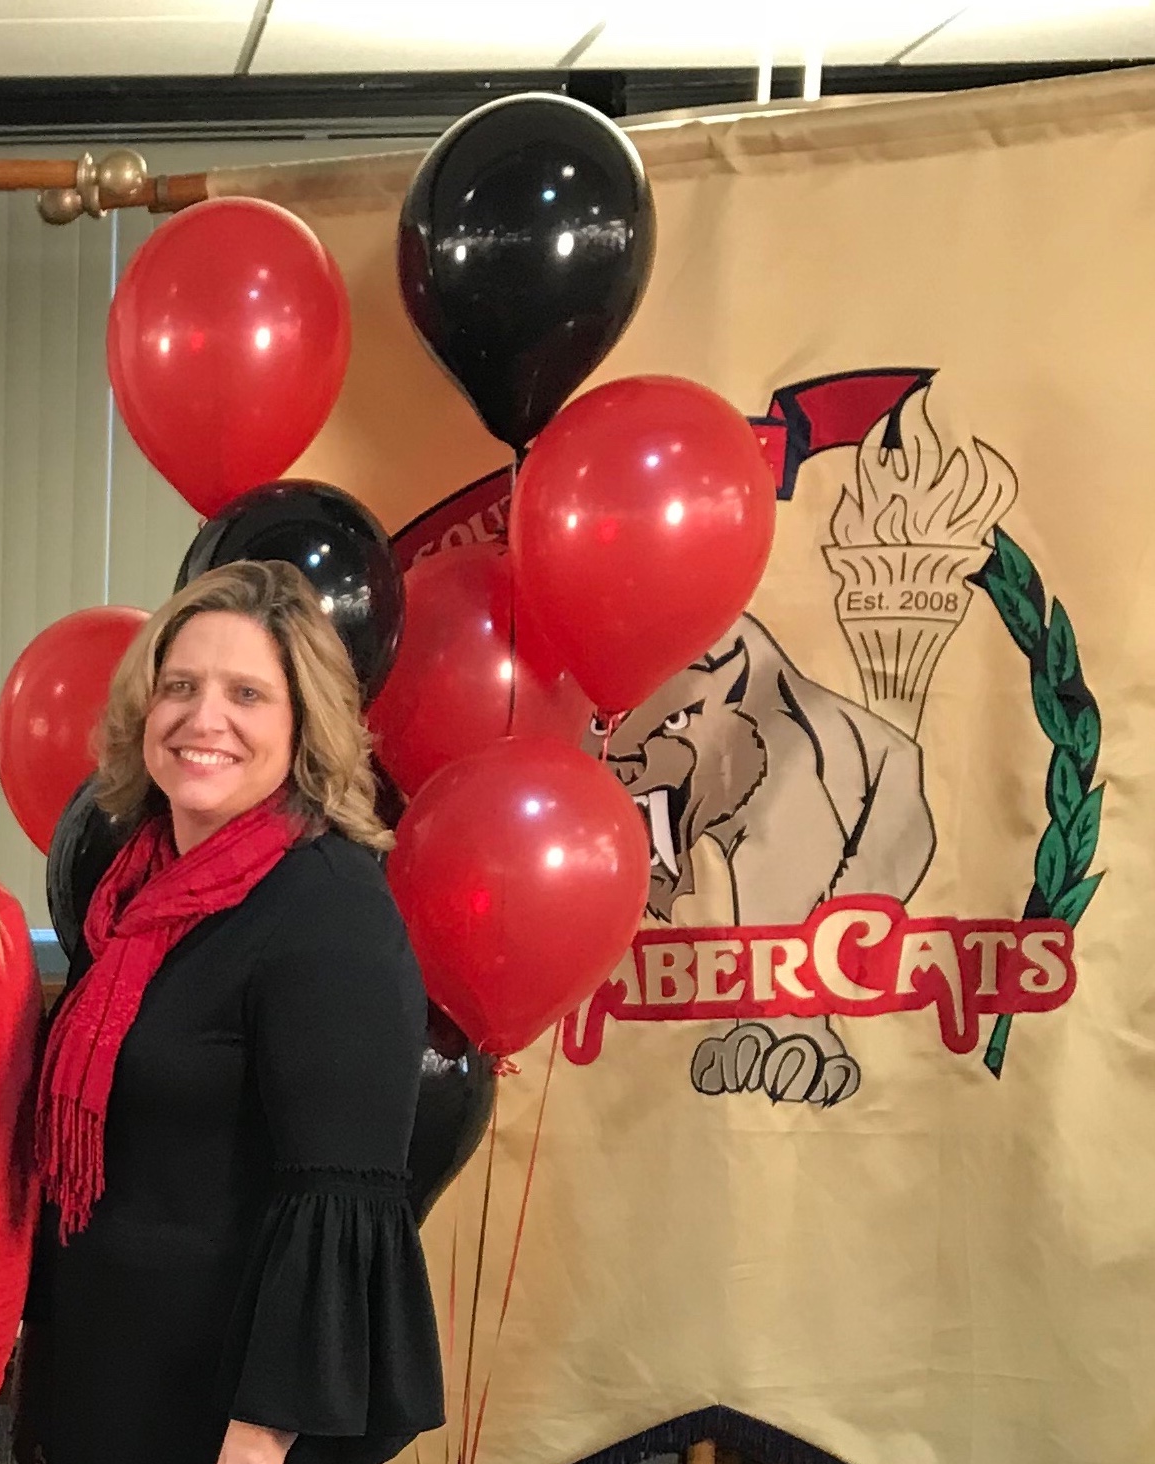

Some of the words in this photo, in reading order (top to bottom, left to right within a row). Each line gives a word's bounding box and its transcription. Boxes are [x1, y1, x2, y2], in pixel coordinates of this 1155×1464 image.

[847, 591, 889, 611] Est.
[899, 590, 958, 613] 2008
[576, 909, 1067, 1049] ABERCATS
